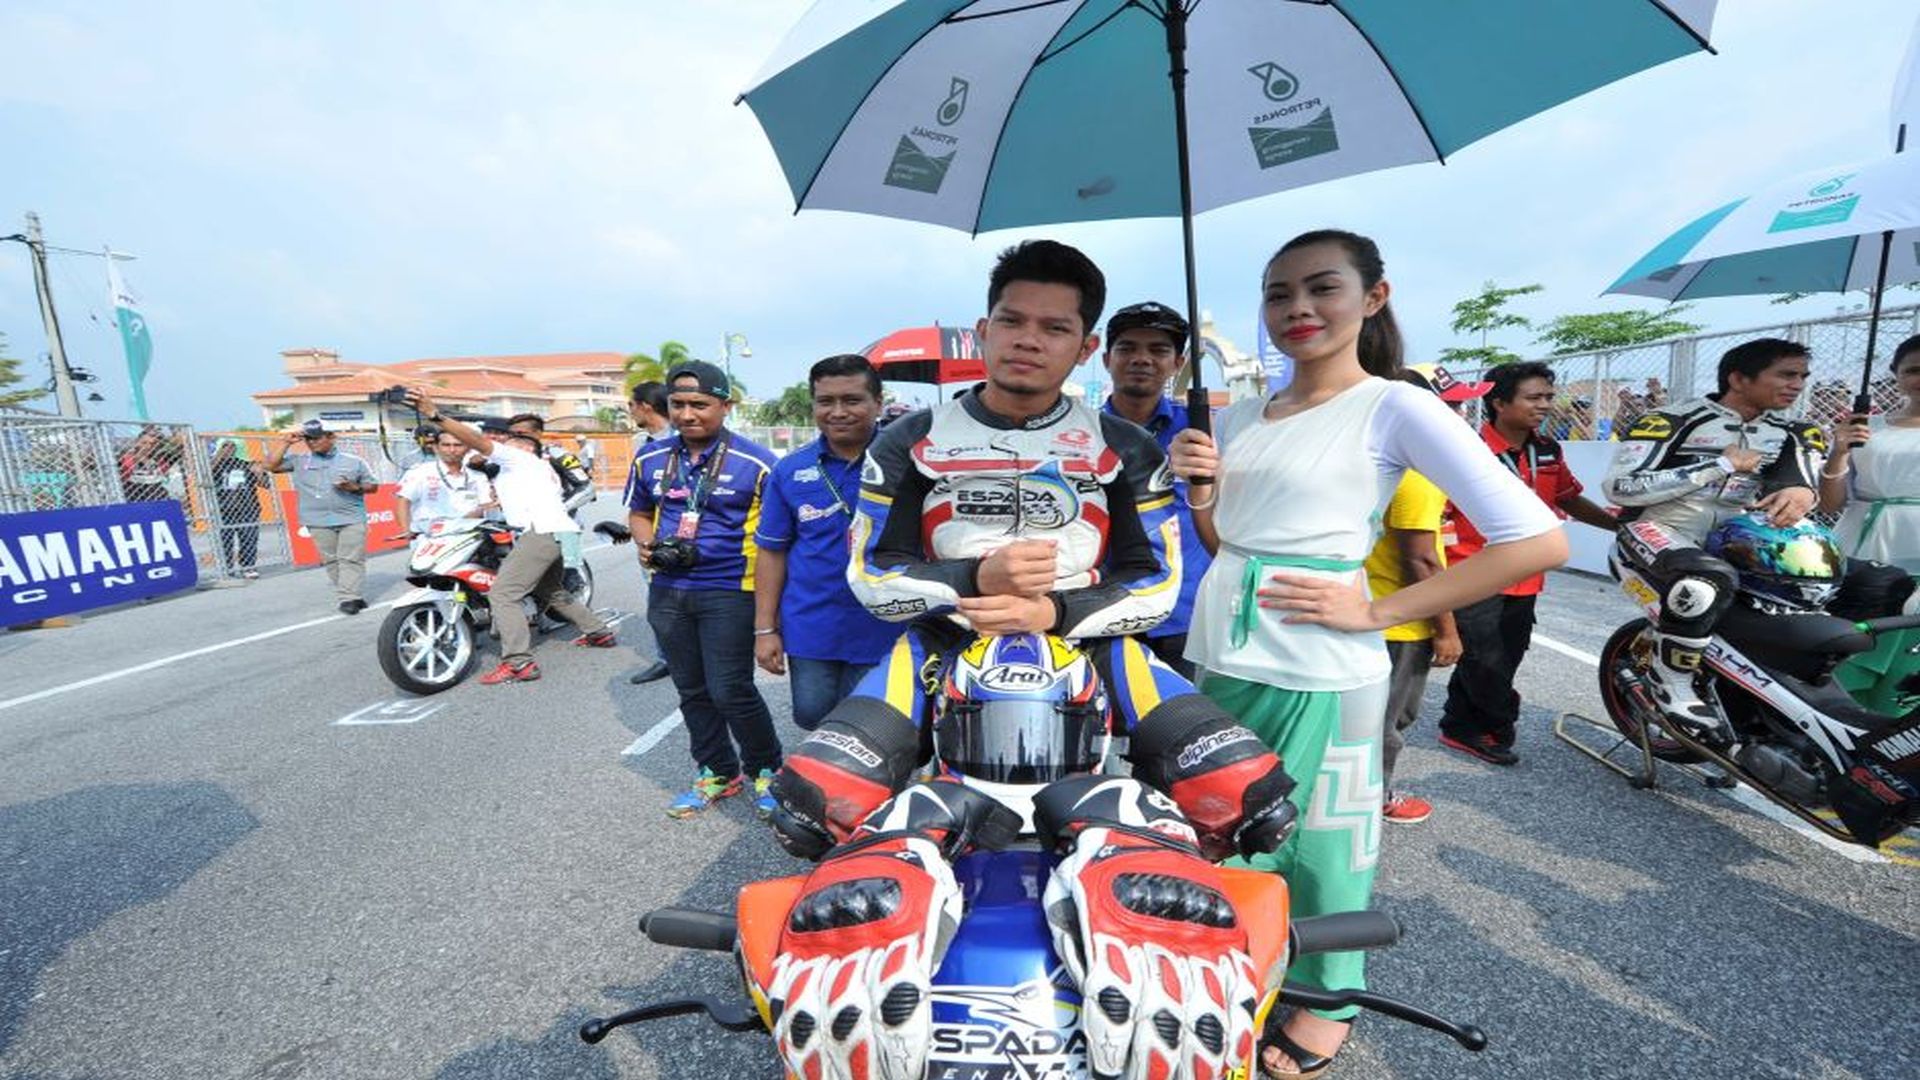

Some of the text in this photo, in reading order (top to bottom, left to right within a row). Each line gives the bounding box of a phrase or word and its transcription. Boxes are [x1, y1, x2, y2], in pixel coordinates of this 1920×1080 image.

[957, 489, 1057, 502] ESPADA
[0, 519, 183, 589] AMAHA
[12, 566, 173, 604] CING
[983, 666, 1043, 683] Arai
[932, 1028, 1088, 1055] SPADA
